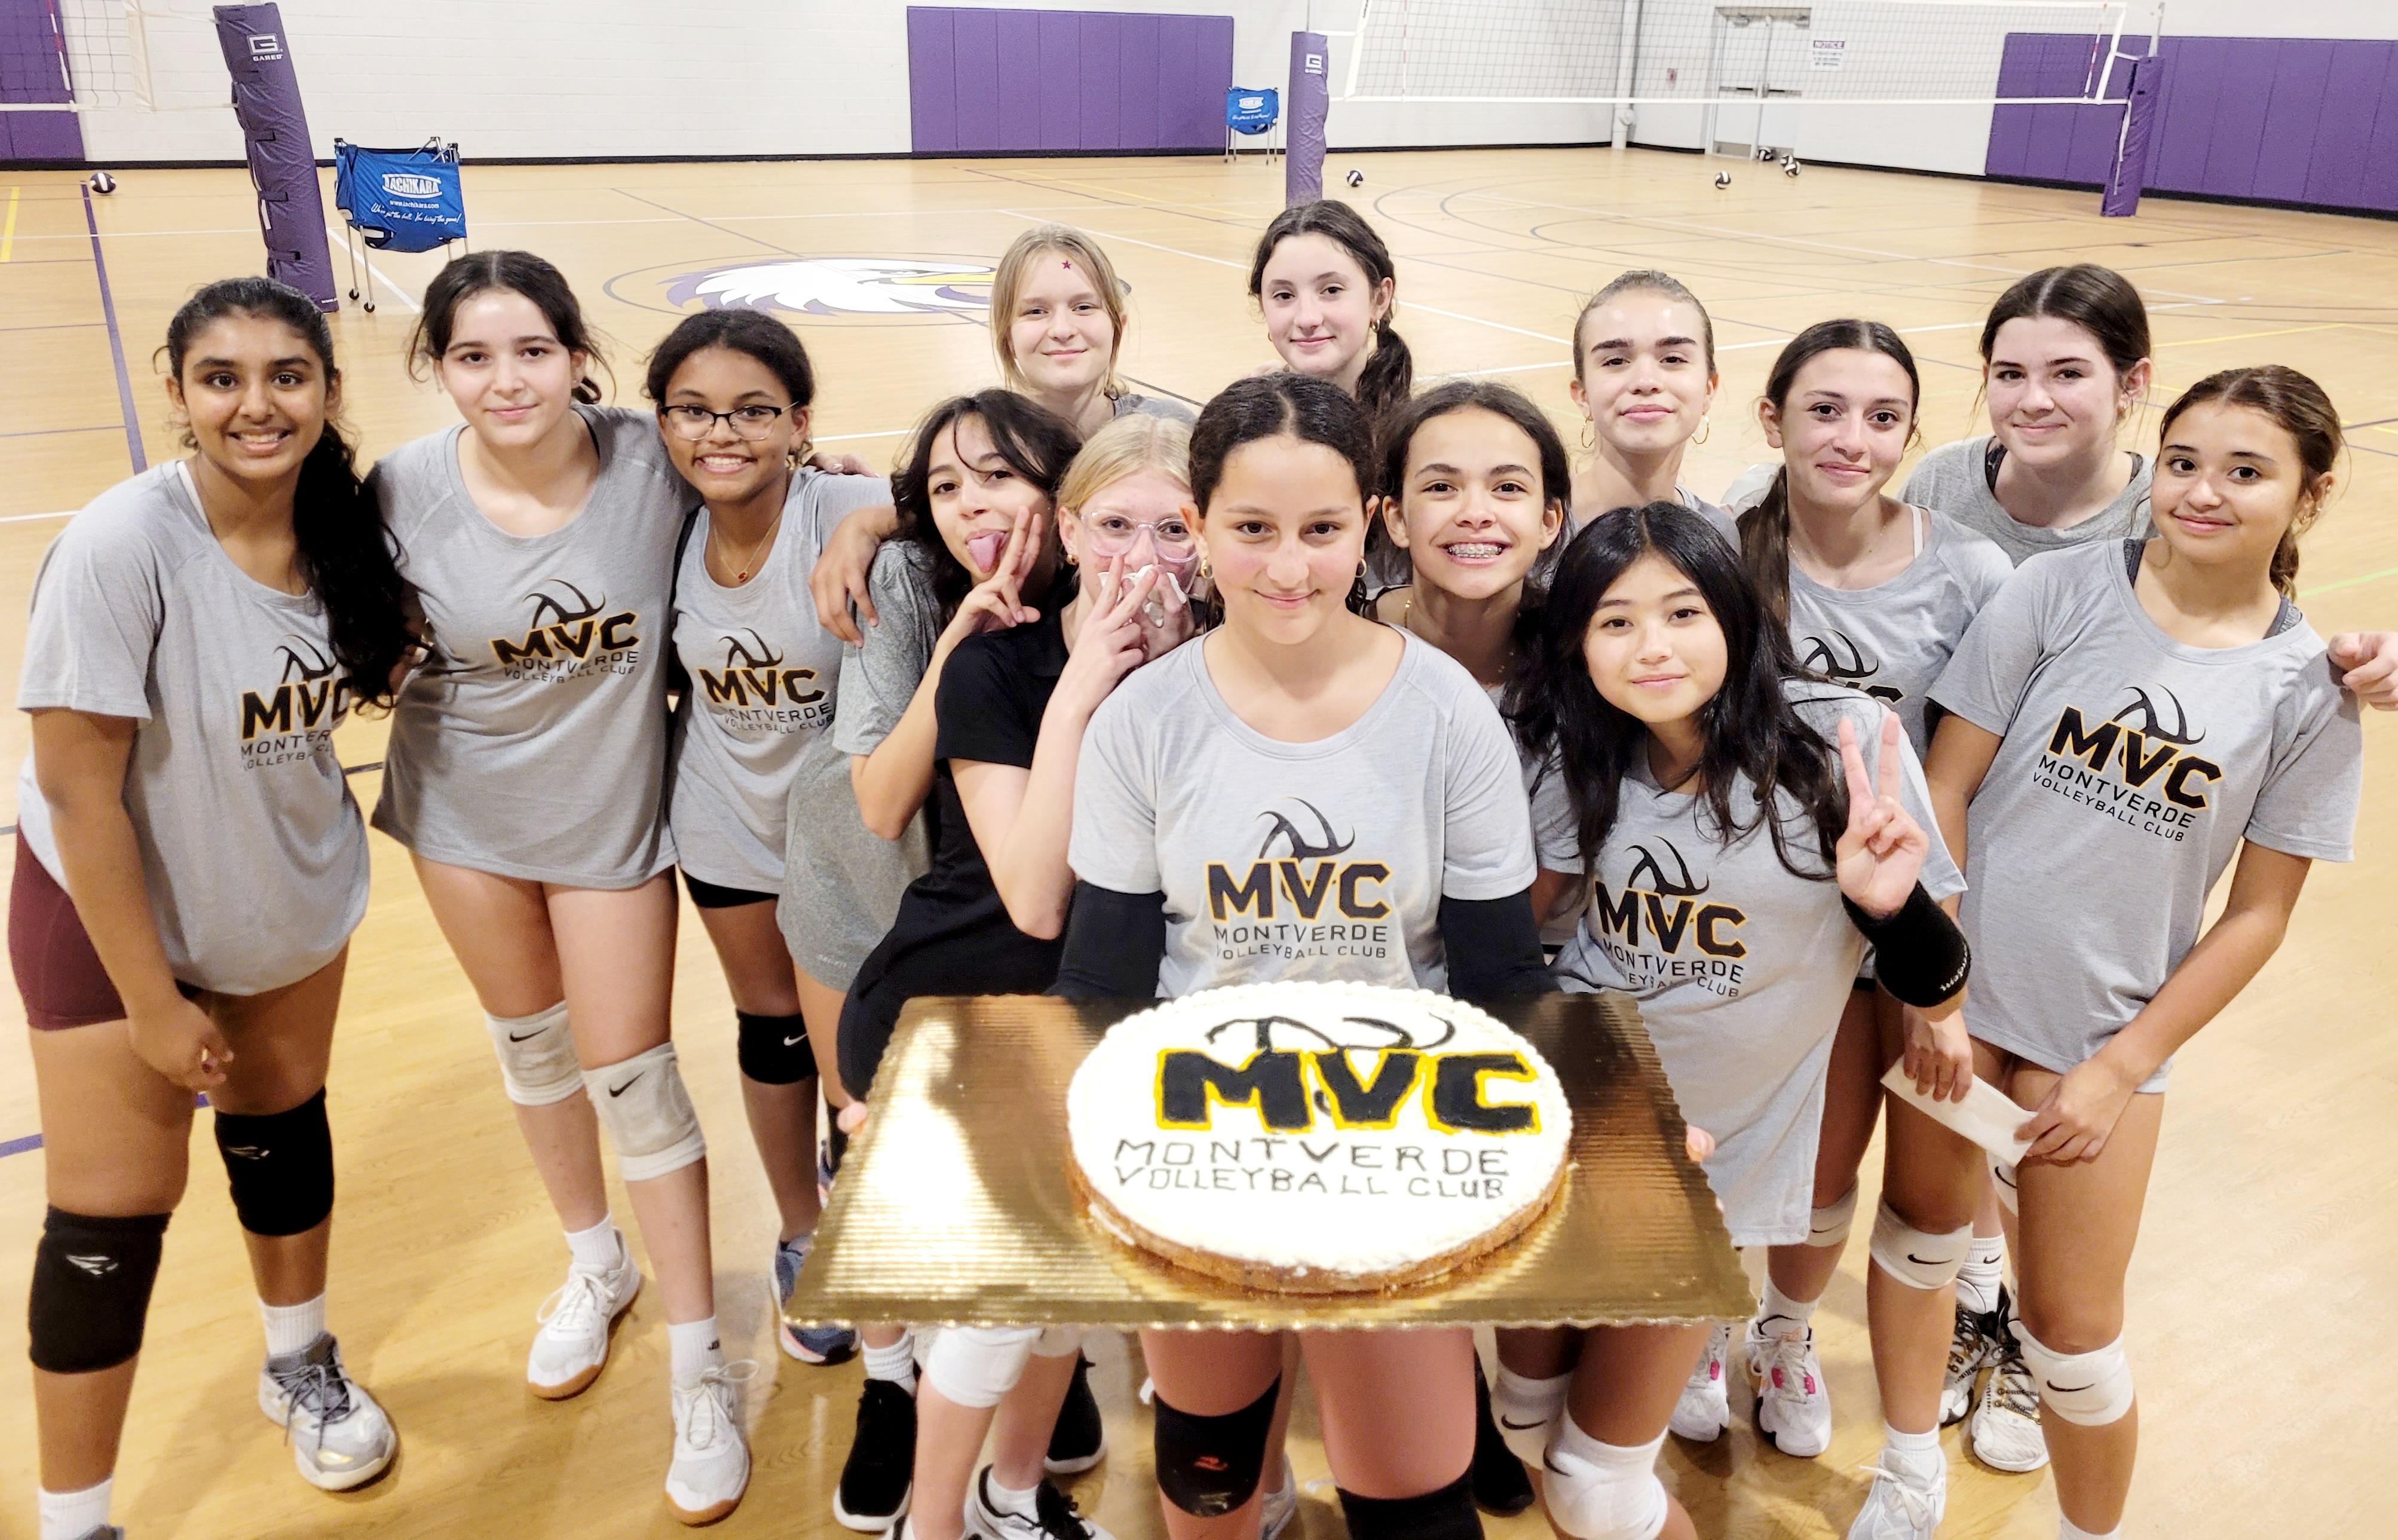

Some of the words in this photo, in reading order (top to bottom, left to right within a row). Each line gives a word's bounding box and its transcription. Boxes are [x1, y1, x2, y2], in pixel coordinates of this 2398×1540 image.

[382, 174, 442, 198] TACHIKARA
[488, 610, 642, 666] MVC
[513, 651, 639, 673] ONTVERDE
[600, 664, 636, 675] CLUB
[696, 668, 828, 707] MVC
[724, 702, 832, 723] ONTVERDE
[800, 714, 835, 734] CLUB
[241, 728, 330, 756] MONTER
[2046, 704, 2224, 811] MVC
[2033, 771, 2136, 826] VOLLEYBALL
[2143, 820, 2185, 841] CLUB
[2038, 755, 2196, 829] MONTVERDE
[1206, 859, 1393, 922] MVC
[1213, 924, 1388, 944] MONTVERDE
[1593, 880, 1748, 960] MVC
[1216, 944, 1329, 960] VOLLEYBALL
[1337, 946, 1387, 959] CLUB
[1603, 938, 1744, 985] MONTVERDE
[1697, 976, 1739, 998] CLUB
[1154, 1048, 1542, 1134] MVC
[1114, 1136, 1511, 1177] MONTVERDE
[1114, 1166, 1389, 1196] VOLLEYBALL
[1408, 1175, 1505, 1199] CLUB
